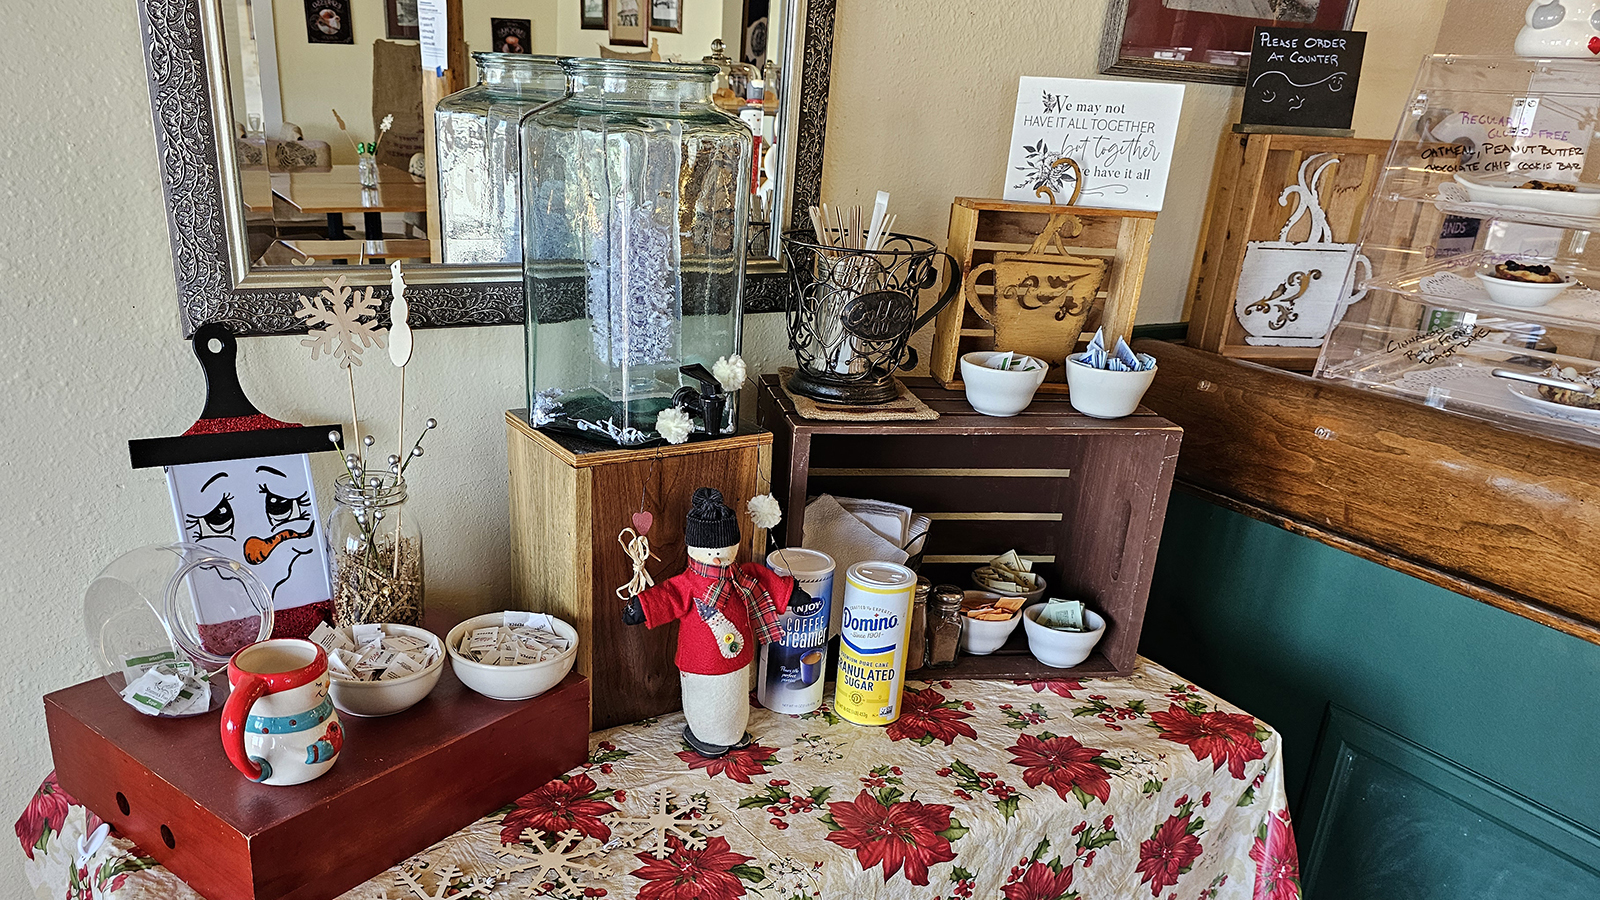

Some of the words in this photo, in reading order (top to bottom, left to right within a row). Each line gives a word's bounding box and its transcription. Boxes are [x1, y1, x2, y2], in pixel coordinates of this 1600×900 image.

[1260, 32, 1299, 48] PLEASE
[1304, 37, 1347, 50] ORDER
[1267, 52, 1285, 62] AT
[1289, 51, 1339, 67] COUNTER
[1076, 103, 1102, 115] may
[1105, 103, 1126, 114] not
[1023, 115, 1053, 128] HAVE
[1055, 116, 1067, 128] IT
[1067, 117, 1088, 130] ALL
[1091, 118, 1156, 134] TOGETHER
[1460, 111, 1513, 127] REGULAR
[1061, 133, 1091, 160] but
[1093, 132, 1161, 167] together
[1482, 142, 1537, 155] PEANUT
[1538, 145, 1585, 157] BUTTER
[1094, 166, 1121, 179] have
[1124, 168, 1133, 179] it
[1136, 168, 1151, 181] all
[1484, 162, 1511, 172] CHIP
[1556, 162, 1582, 171] BAR
[1386, 327, 1446, 353] CINNAMON
[1419, 345, 1456, 365] TOAST
[786, 616, 825, 632] COFFEE
[844, 606, 898, 631] Domino
[838, 657, 895, 681] RANULATED
[844, 675, 874, 691] SUGAR
